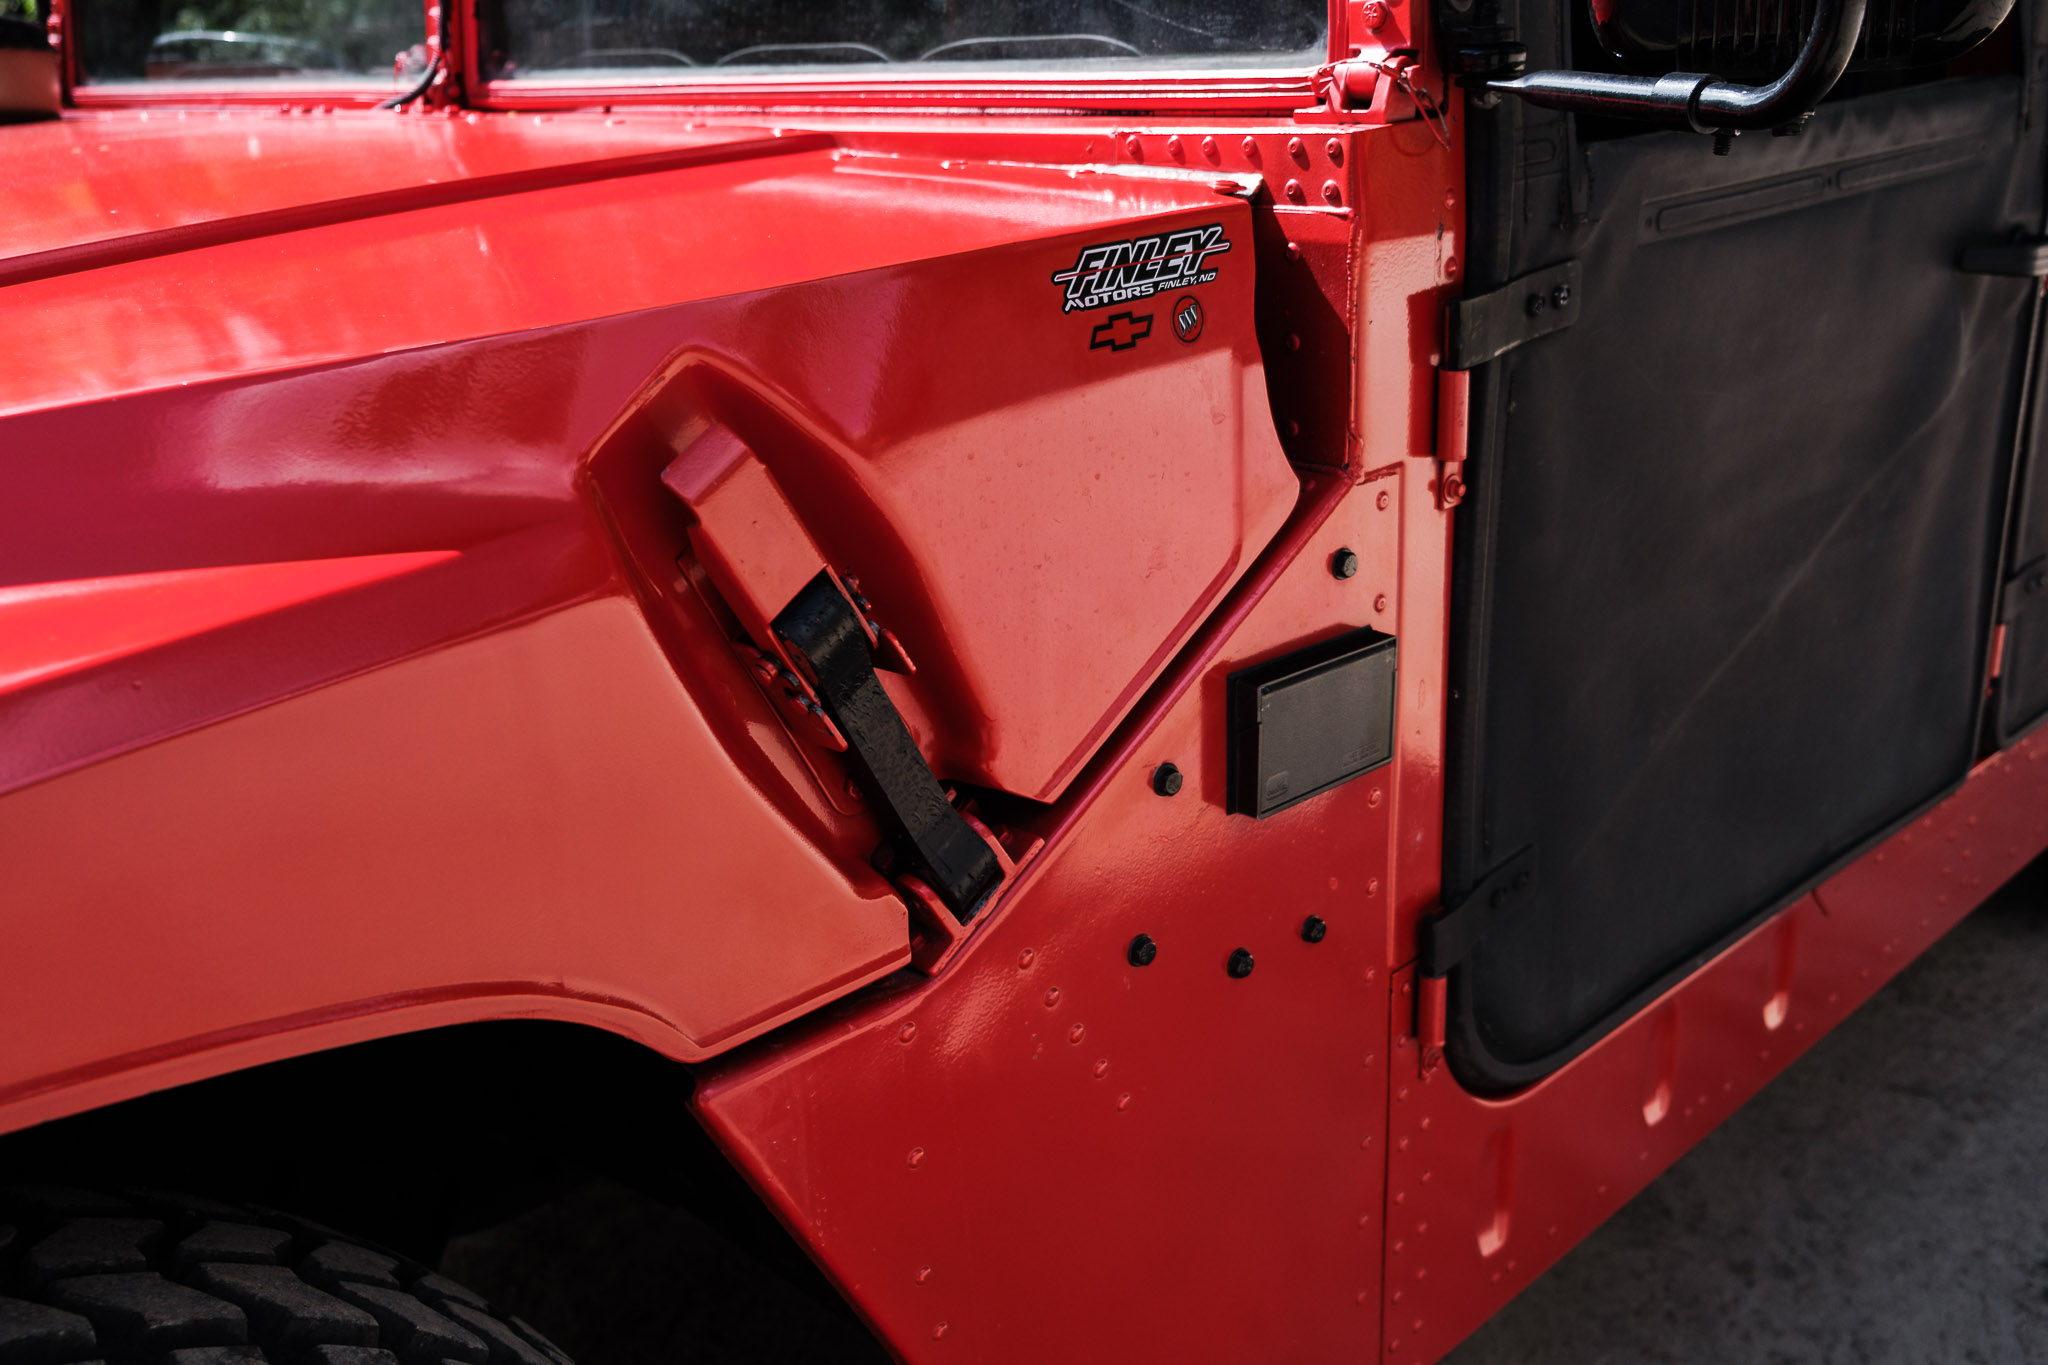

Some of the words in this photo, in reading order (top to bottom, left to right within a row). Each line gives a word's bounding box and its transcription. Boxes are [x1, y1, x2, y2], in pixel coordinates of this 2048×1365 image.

[1067, 226, 1222, 298] FINLEY
[1158, 276, 1197, 291] FINLEY,
[1199, 272, 1216, 282] ND
[1065, 284, 1154, 311] MOTORS
